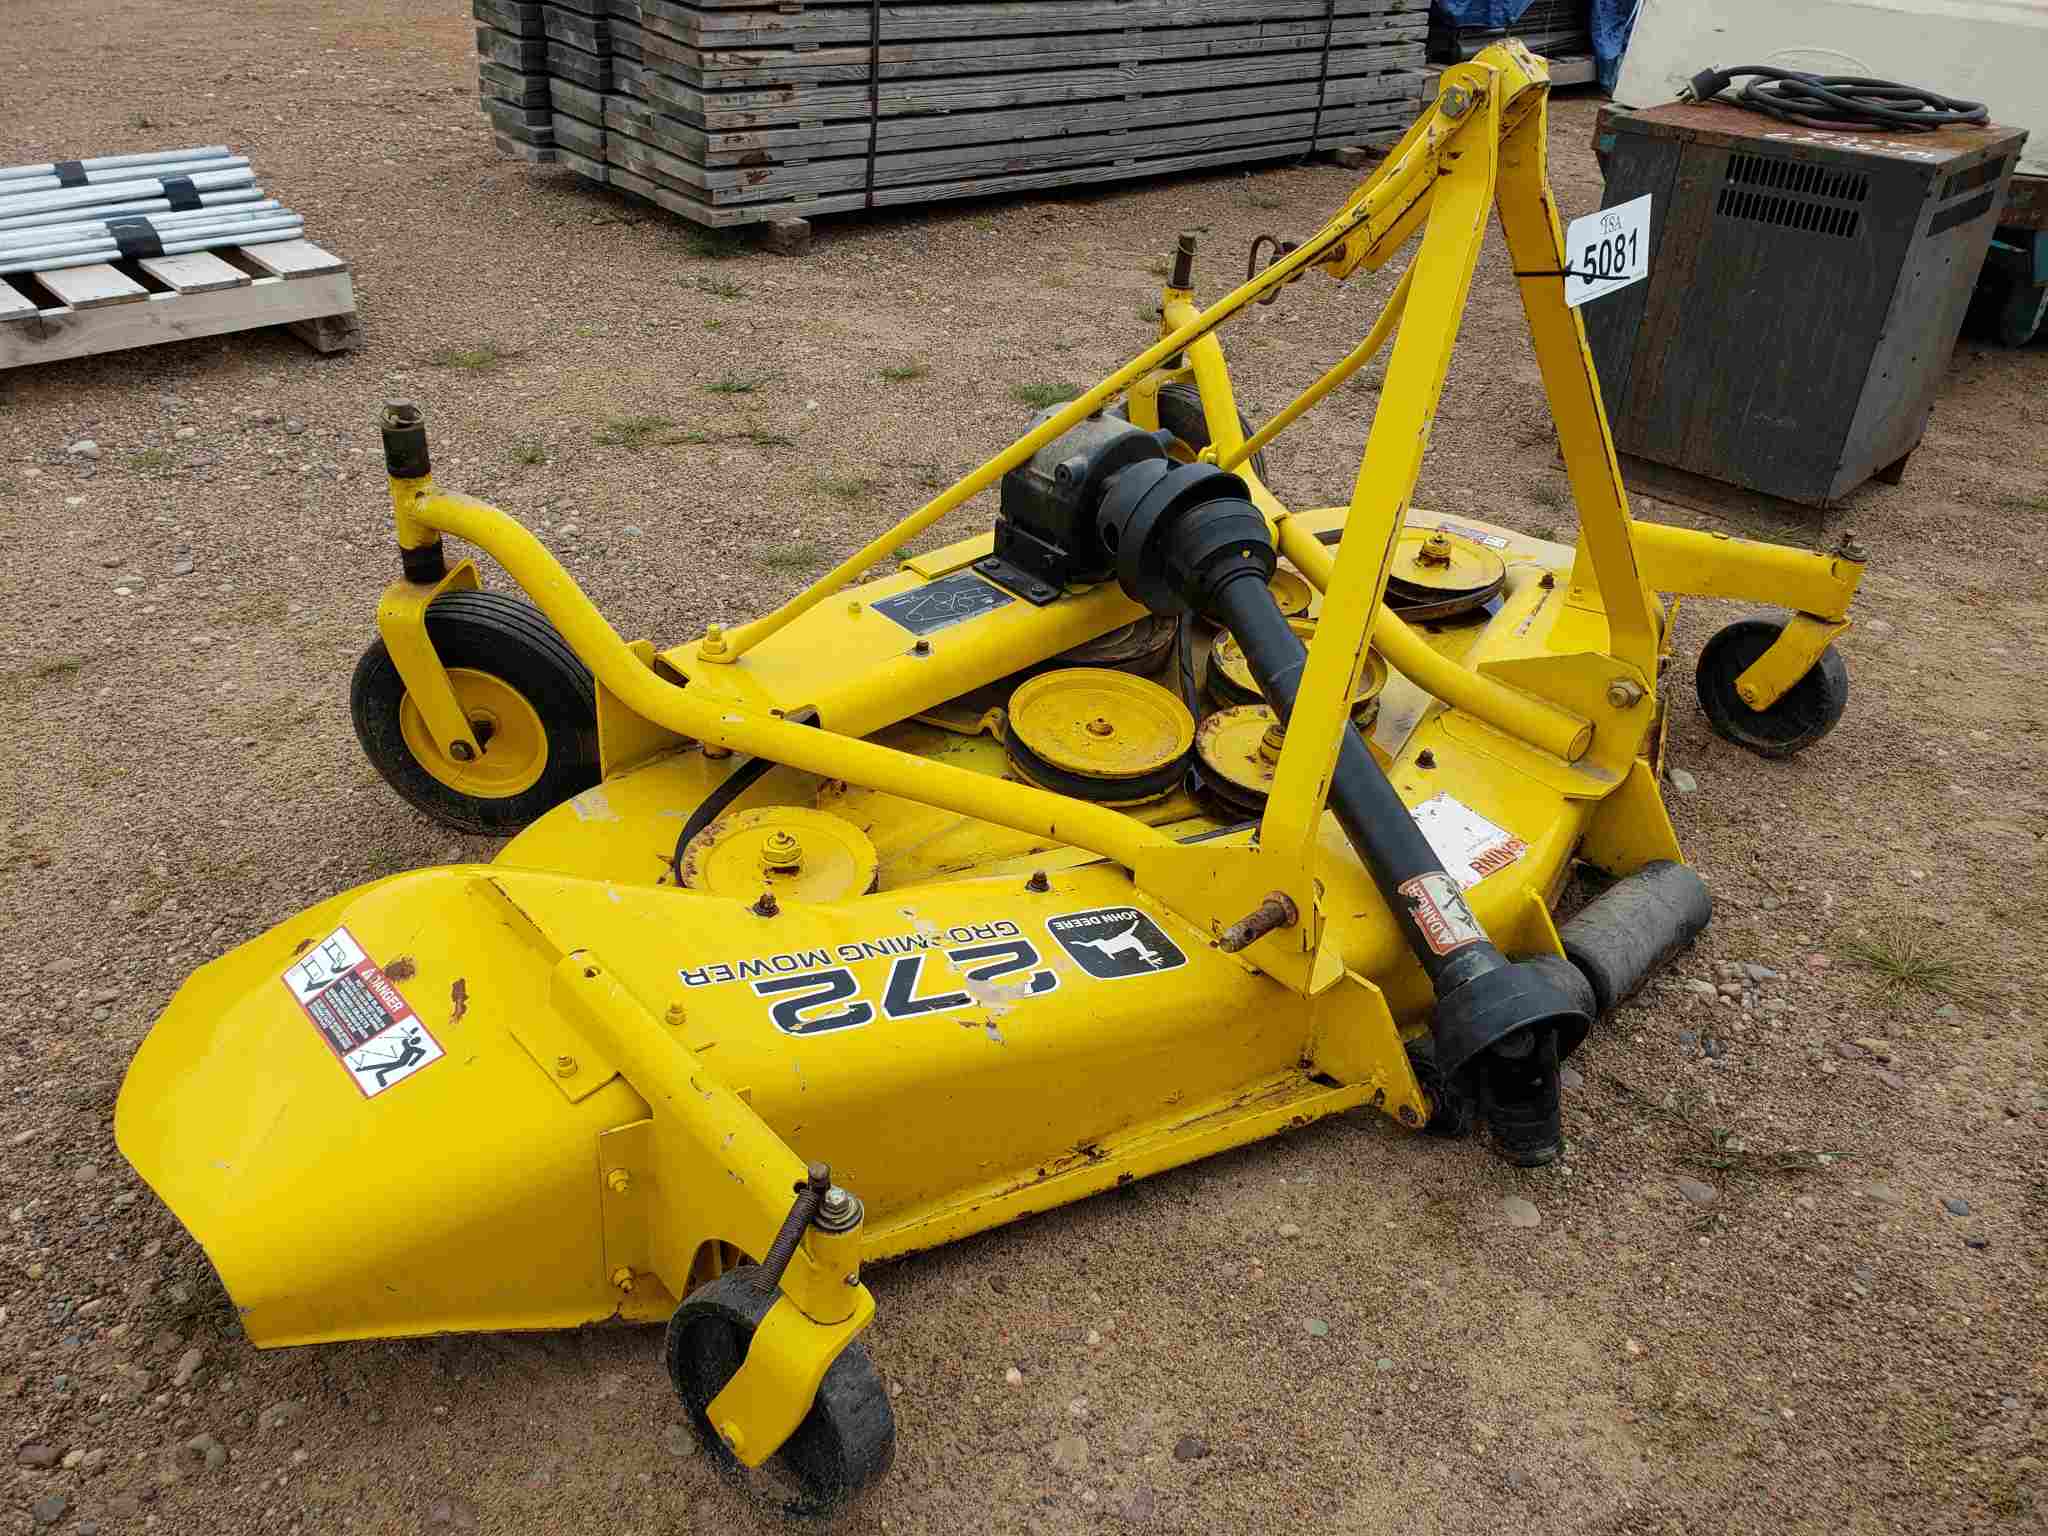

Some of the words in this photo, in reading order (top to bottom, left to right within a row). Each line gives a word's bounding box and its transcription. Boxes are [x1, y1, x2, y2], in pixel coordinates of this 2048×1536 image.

[1599, 212, 1623, 235] TSA
[1584, 227, 1638, 285] 5081
[1052, 916, 1101, 930] DEERE
[1101, 909, 1138, 924] JOHN
[837, 920, 1021, 962] GROMING
[680, 948, 832, 987] MOWER
[752, 937, 1060, 1036] 272
[368, 973, 402, 1013] DANGER
